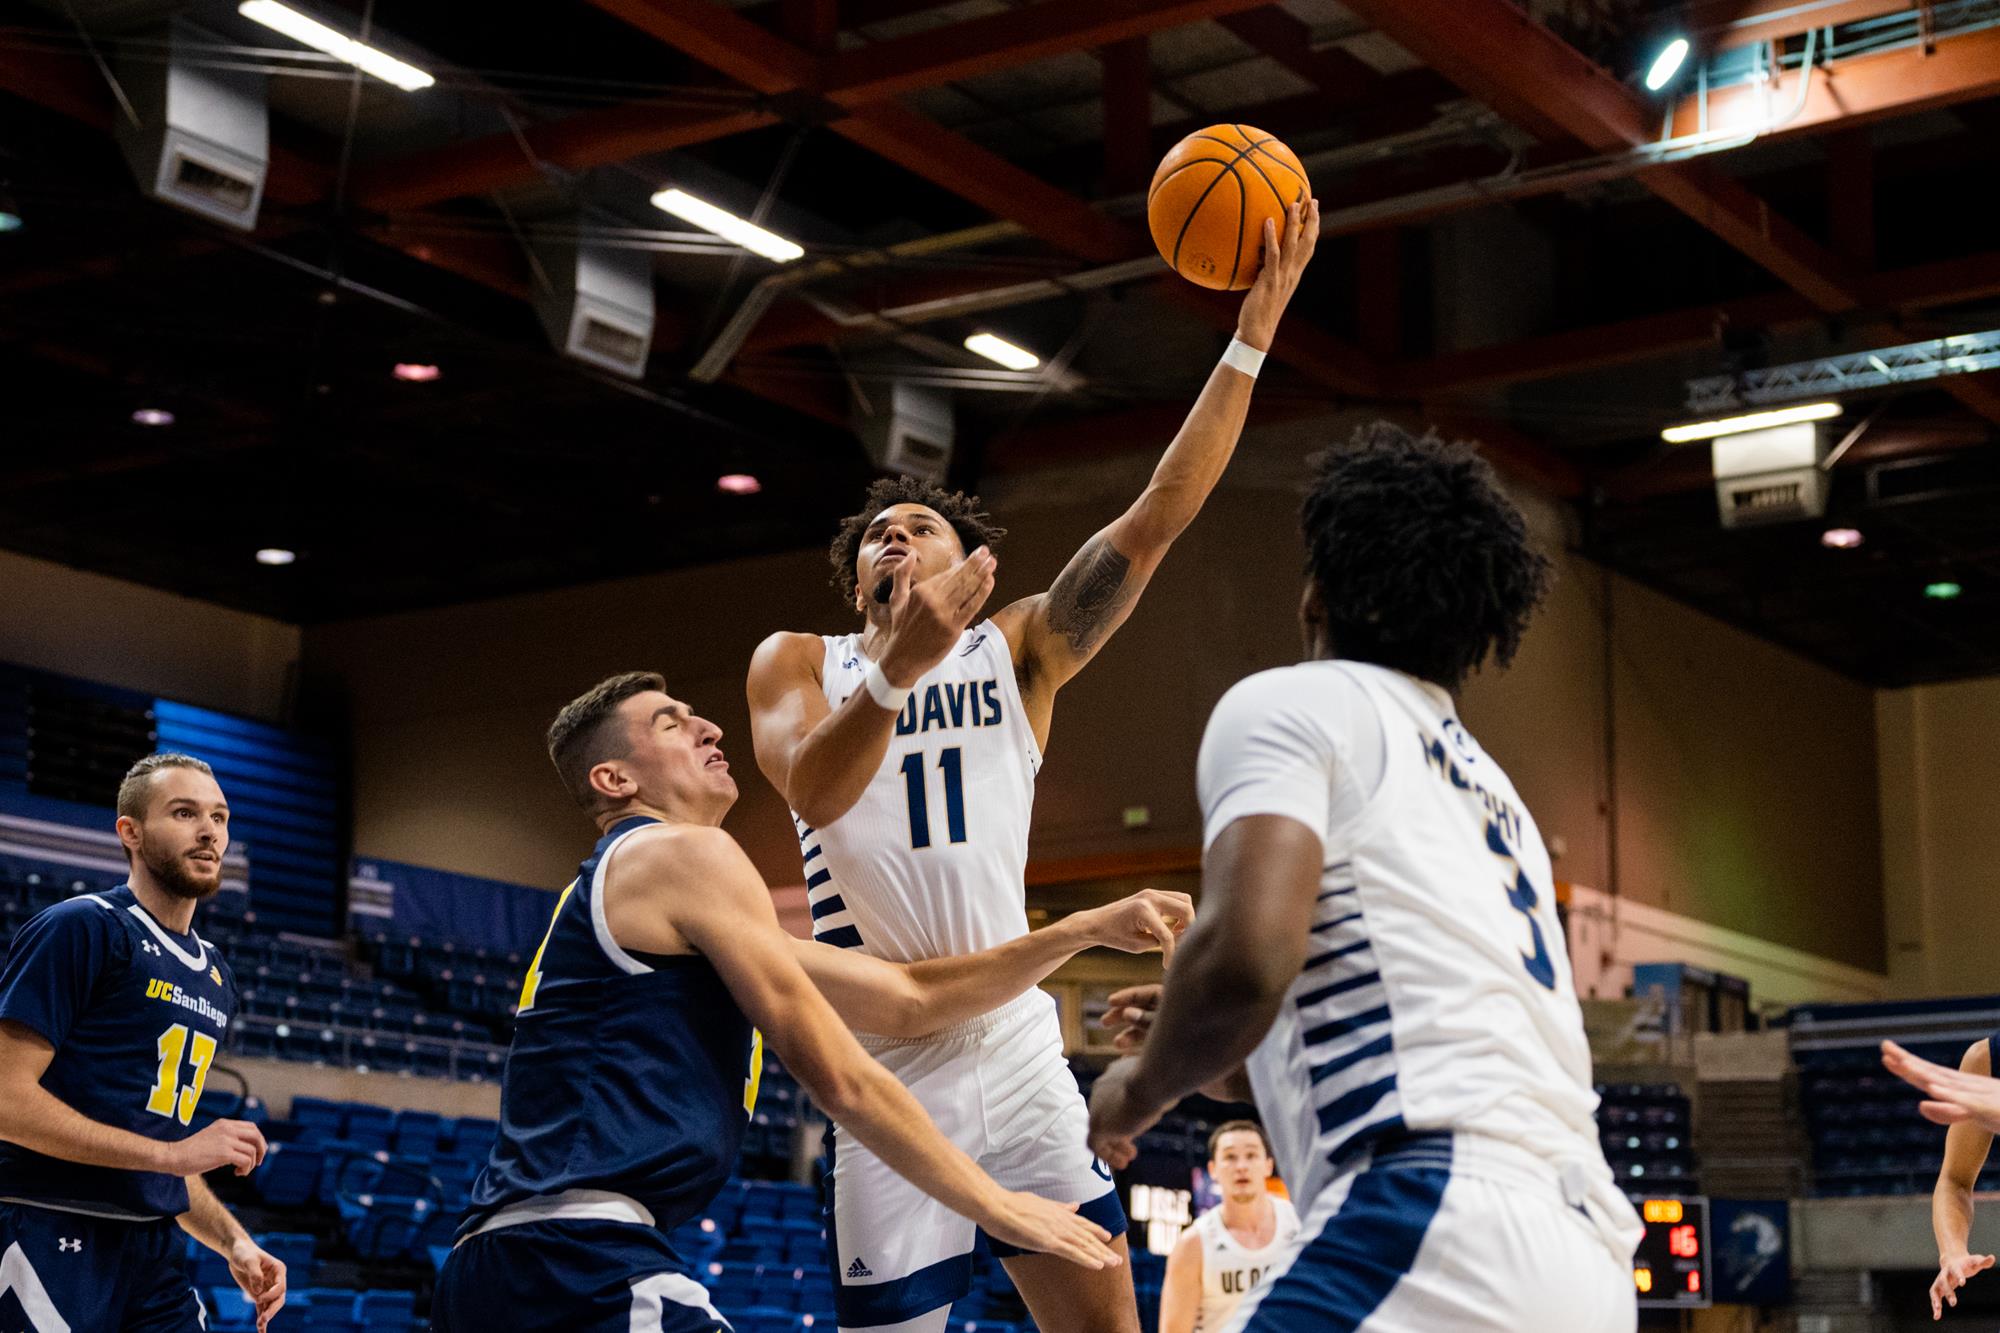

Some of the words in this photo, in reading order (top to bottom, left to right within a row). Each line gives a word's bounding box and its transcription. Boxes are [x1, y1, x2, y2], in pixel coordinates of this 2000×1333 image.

[895, 679, 1003, 737] DAVIS
[898, 744, 968, 850] 11
[1483, 816, 1557, 992] 3
[145, 1022, 219, 1127] 13
[1221, 1270, 1245, 1294] UC
